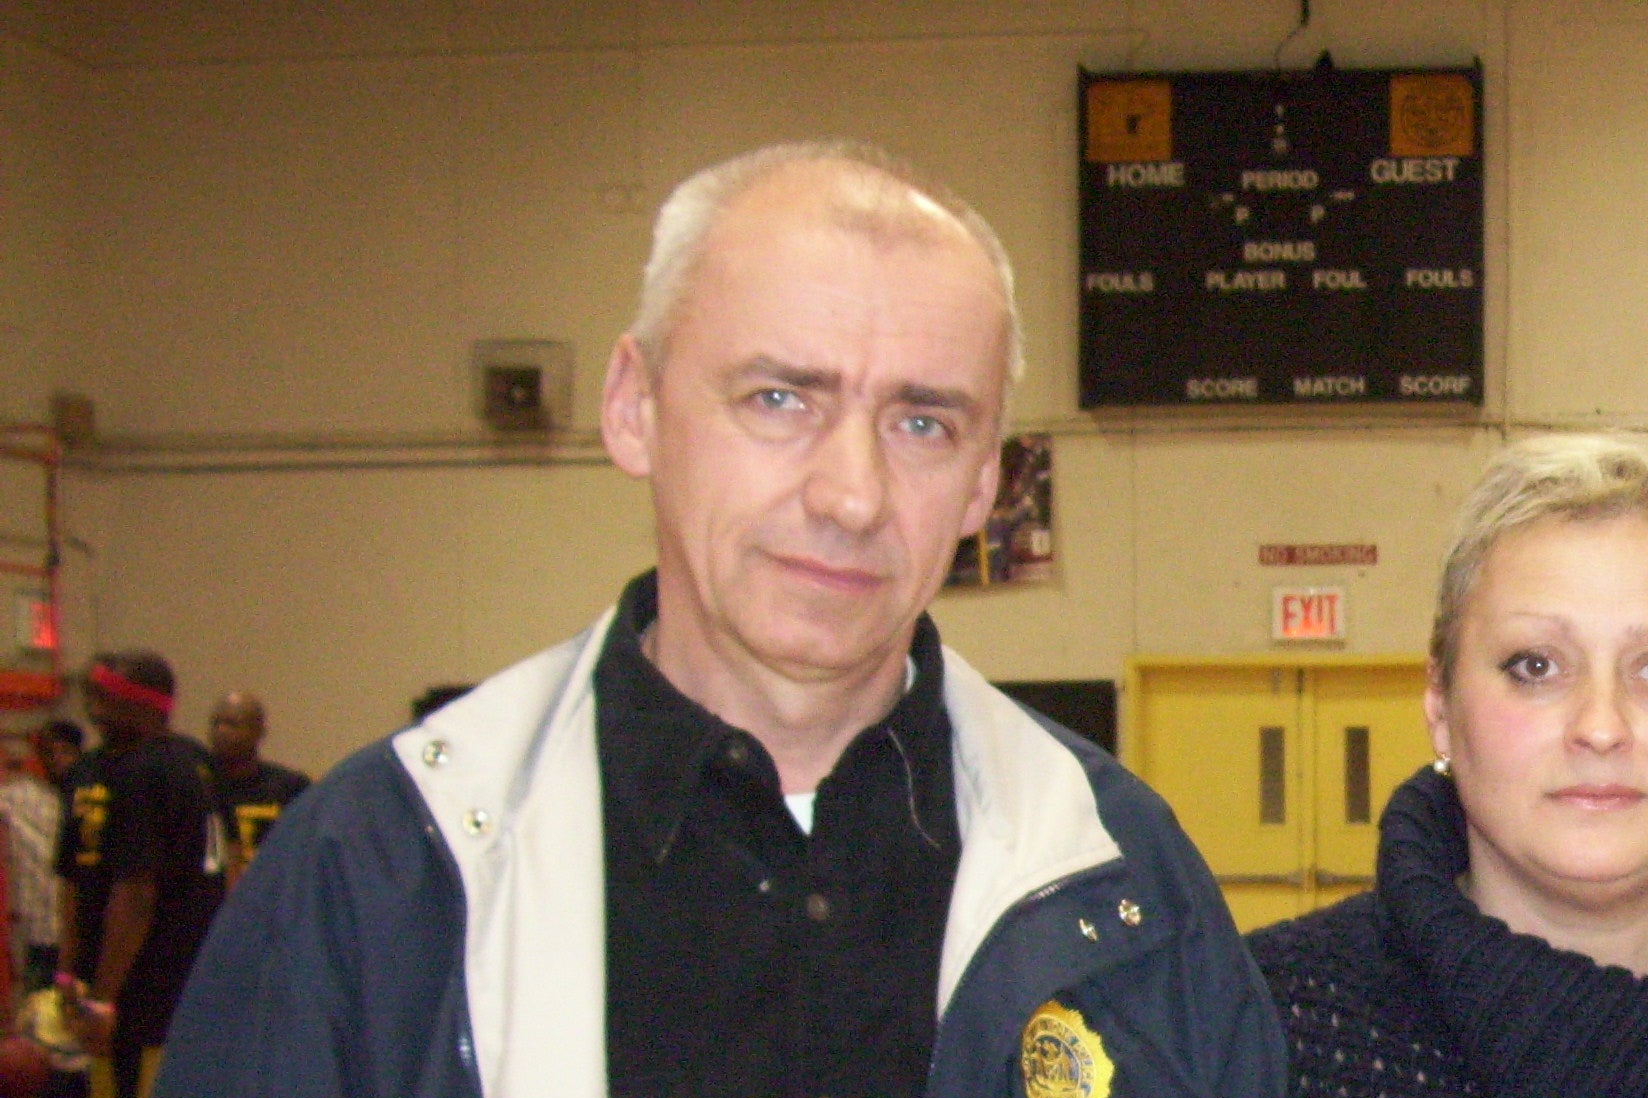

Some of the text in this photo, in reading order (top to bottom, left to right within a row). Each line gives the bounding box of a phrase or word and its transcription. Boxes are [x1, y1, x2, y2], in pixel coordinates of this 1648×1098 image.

[1107, 163, 1184, 187] HOME
[1242, 170, 1319, 190] PERIOD
[1370, 159, 1459, 183] GUEST
[1244, 241, 1316, 262] BONUS
[1087, 272, 1153, 292] FOULS
[1206, 270, 1367, 290] PLAYER FOUL
[1406, 269, 1474, 288] FOULS
[1186, 378, 1259, 399] SCORE
[1293, 376, 1366, 397] MATCH
[1400, 375, 1472, 395] SCORE
[1282, 594, 1338, 637] EXIT
